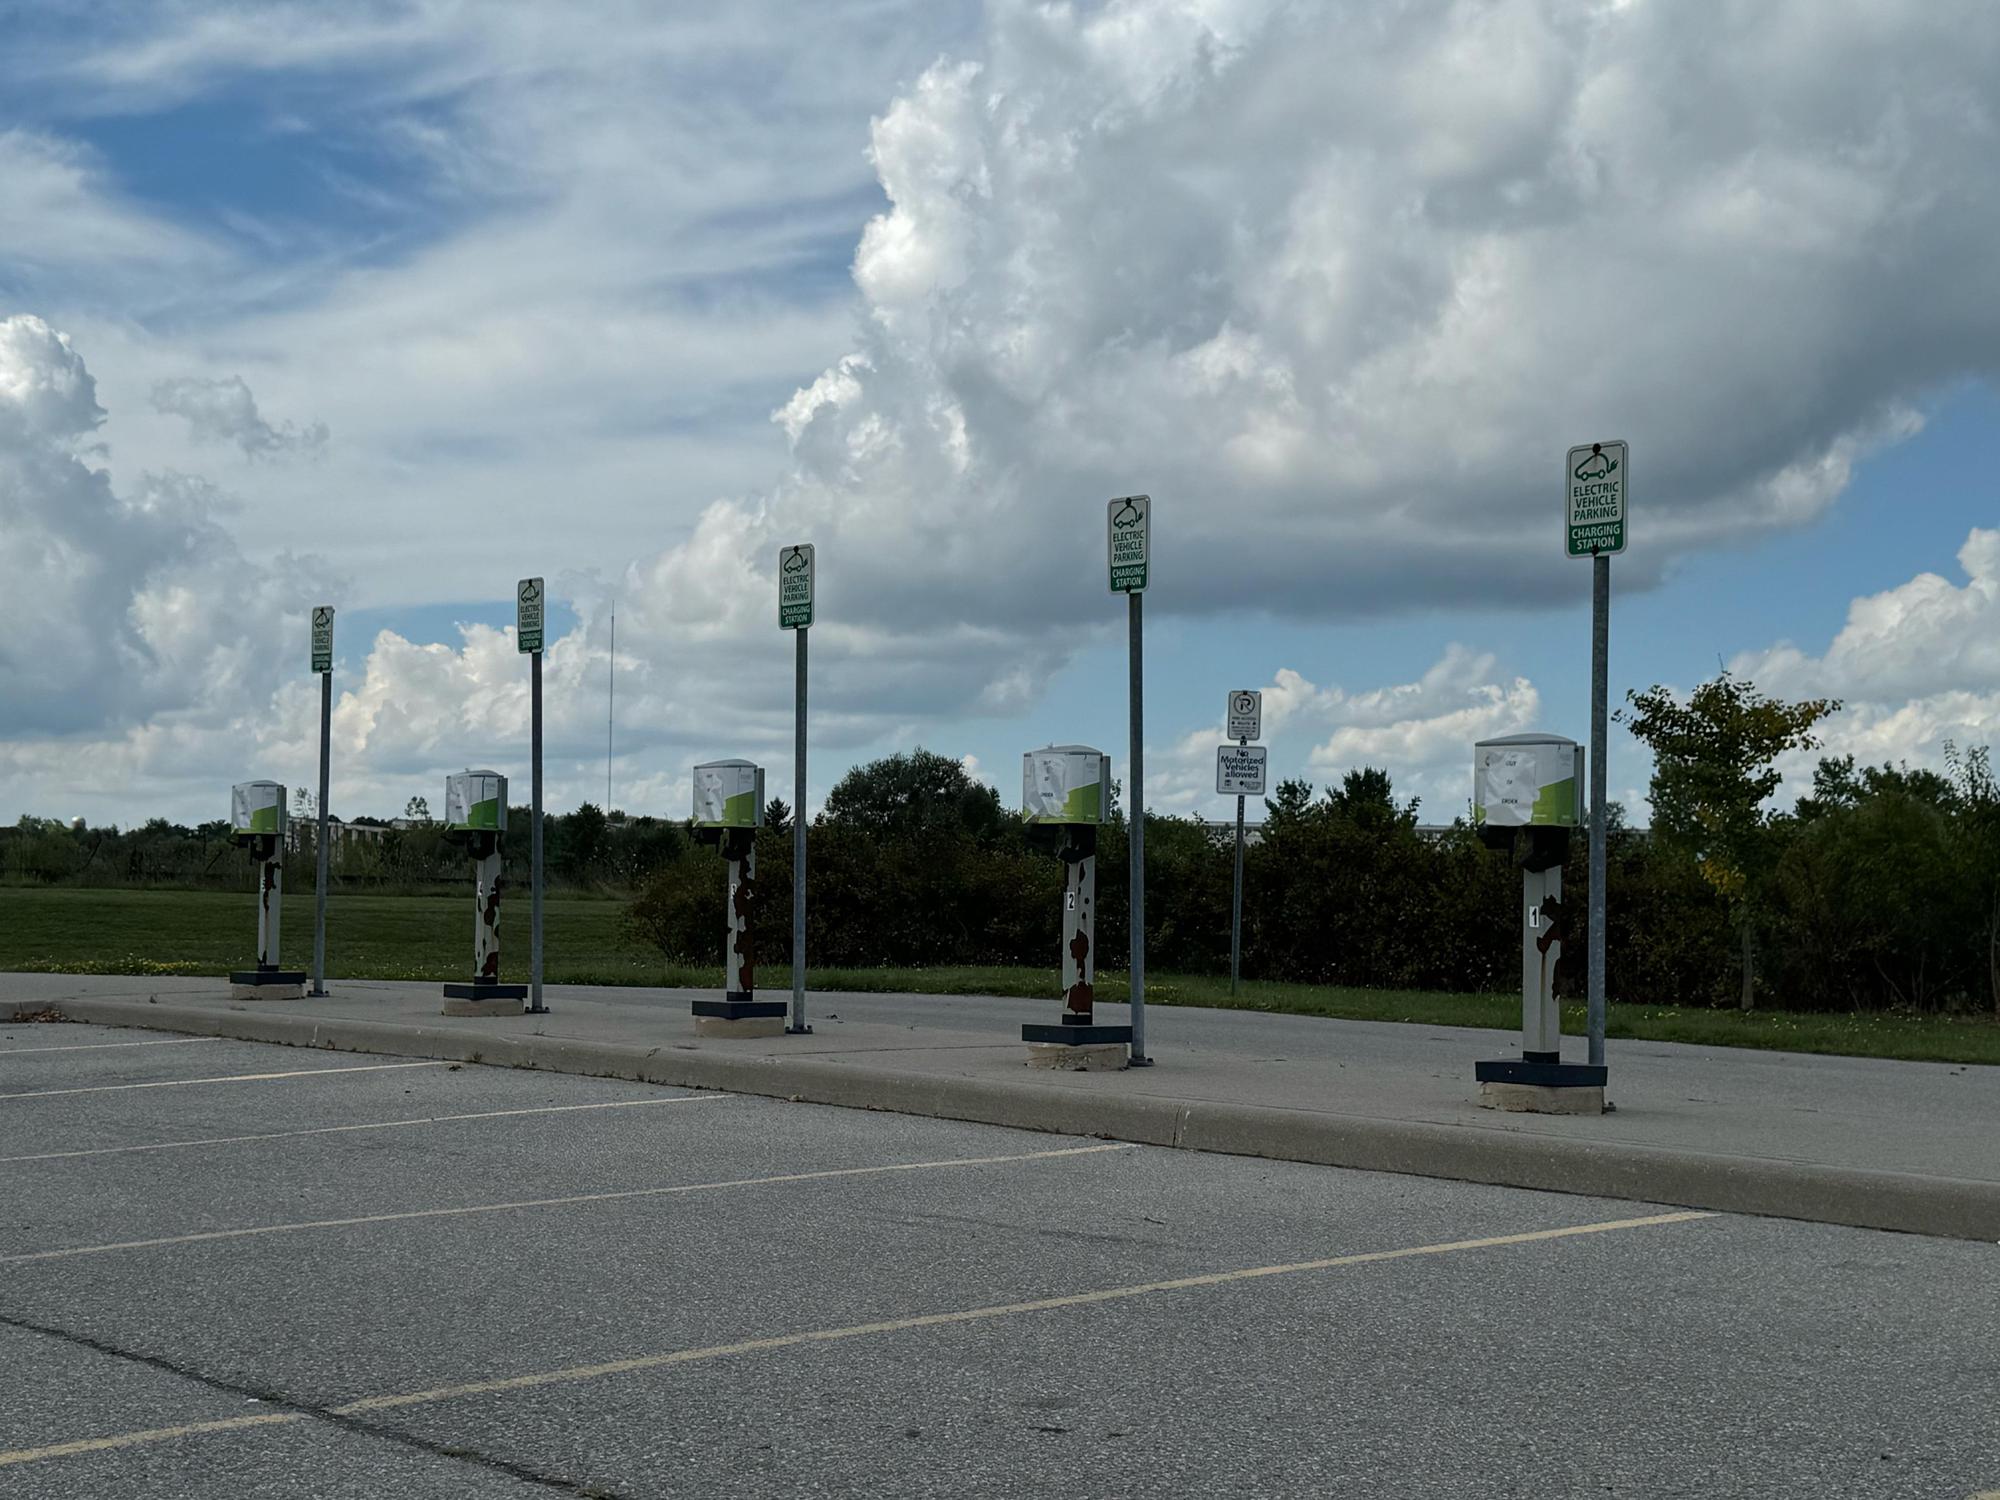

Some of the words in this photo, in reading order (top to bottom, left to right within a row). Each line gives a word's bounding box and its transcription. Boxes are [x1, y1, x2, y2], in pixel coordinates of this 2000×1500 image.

[1573, 481, 1619, 497] ELECTRIC
[1576, 494, 1617, 508] VEHICLE
[1574, 506, 1618, 521] PARKING
[1113, 530, 1144, 542] ELECTRIC
[1571, 524, 1621, 539] CHARGING
[1115, 540, 1143, 552] VEHICLE
[1577, 536, 1615, 550] STATION
[1114, 551, 1144, 562] PARKING
[1112, 565, 1145, 578] CHARGING
[1116, 577, 1142, 588] STATION
[1236, 749, 1249, 757] No
[1220, 755, 1264, 765] Motorized
[1225, 761, 1259, 772] Vehicles
[1225, 768, 1259, 779] allowed
[1068, 893, 1074, 909] 2
[1532, 907, 1537, 926] 1
